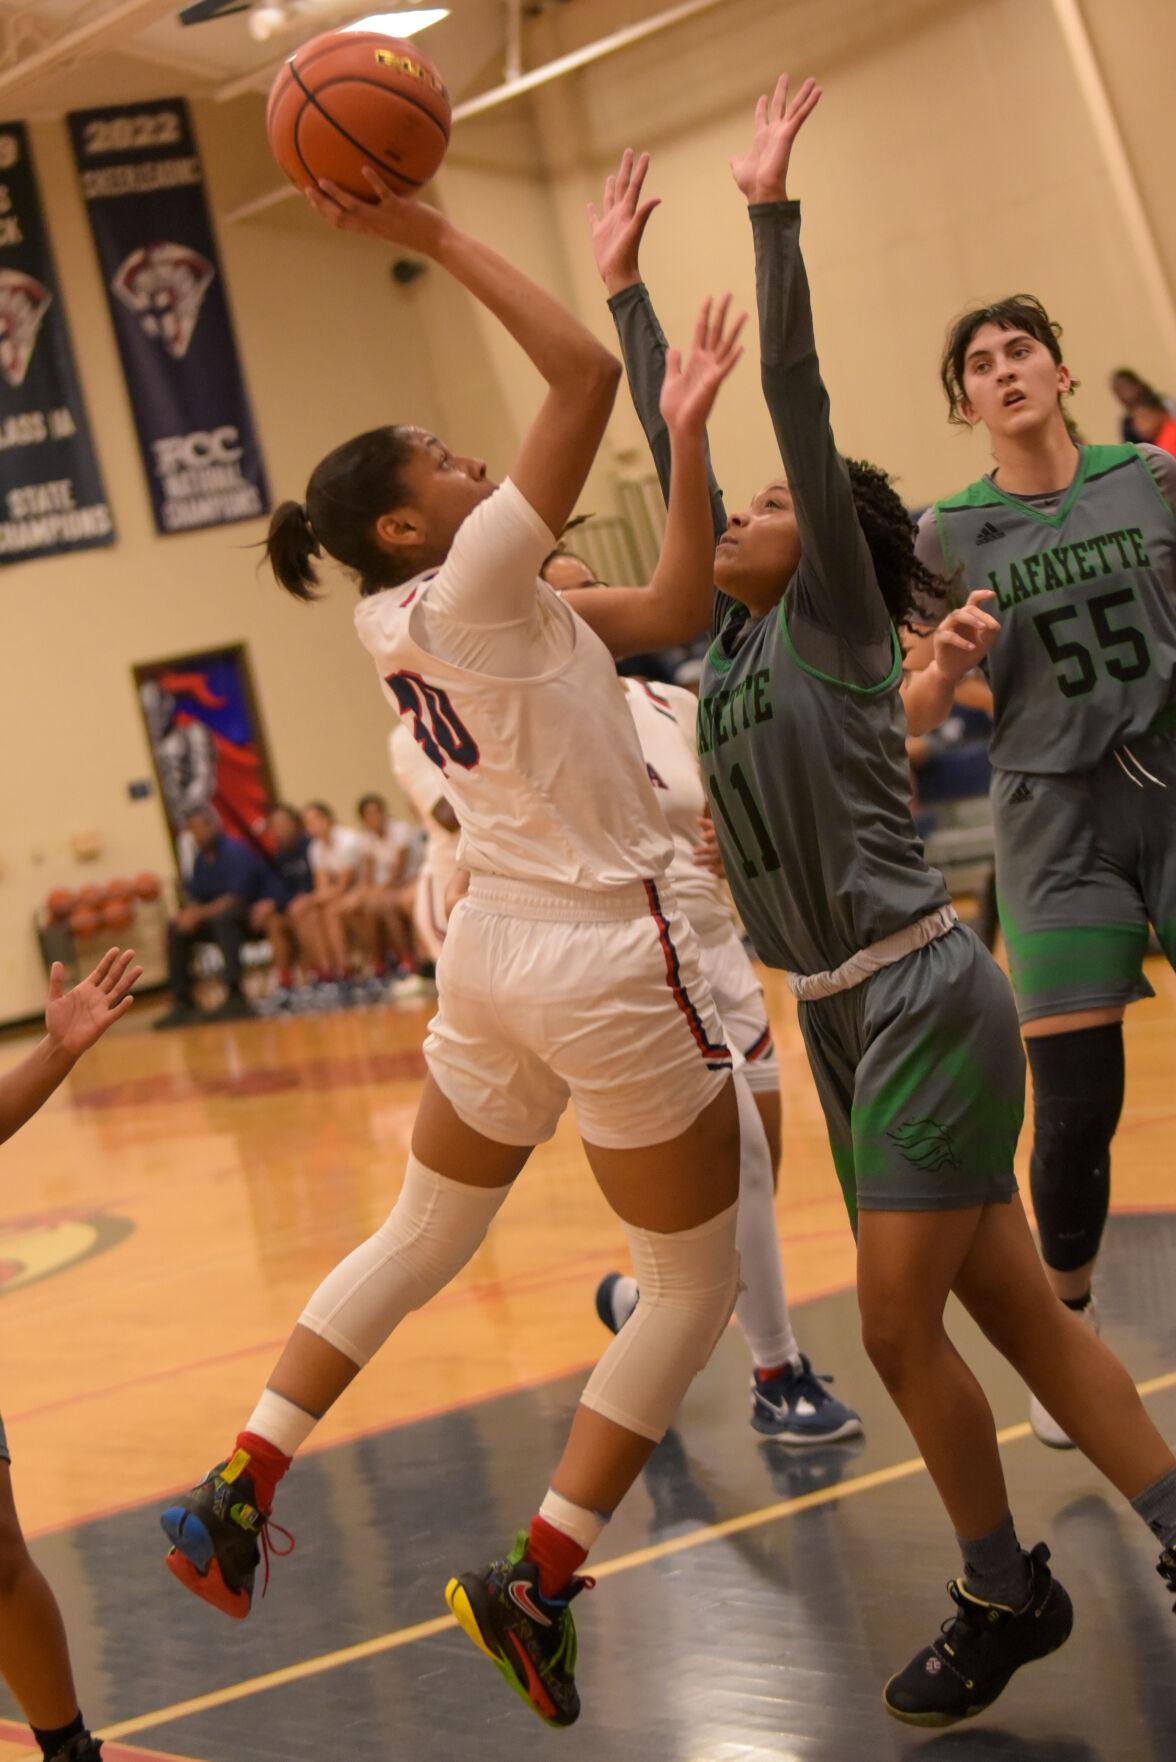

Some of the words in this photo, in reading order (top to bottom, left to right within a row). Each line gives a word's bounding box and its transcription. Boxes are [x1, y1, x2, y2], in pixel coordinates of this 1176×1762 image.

[83, 111, 183, 155] 2022
[7, 479, 76, 520] STATE
[988, 527, 1151, 612] LAFAYETTE
[1032, 587, 1151, 699] 55
[708, 762, 782, 880] 11
